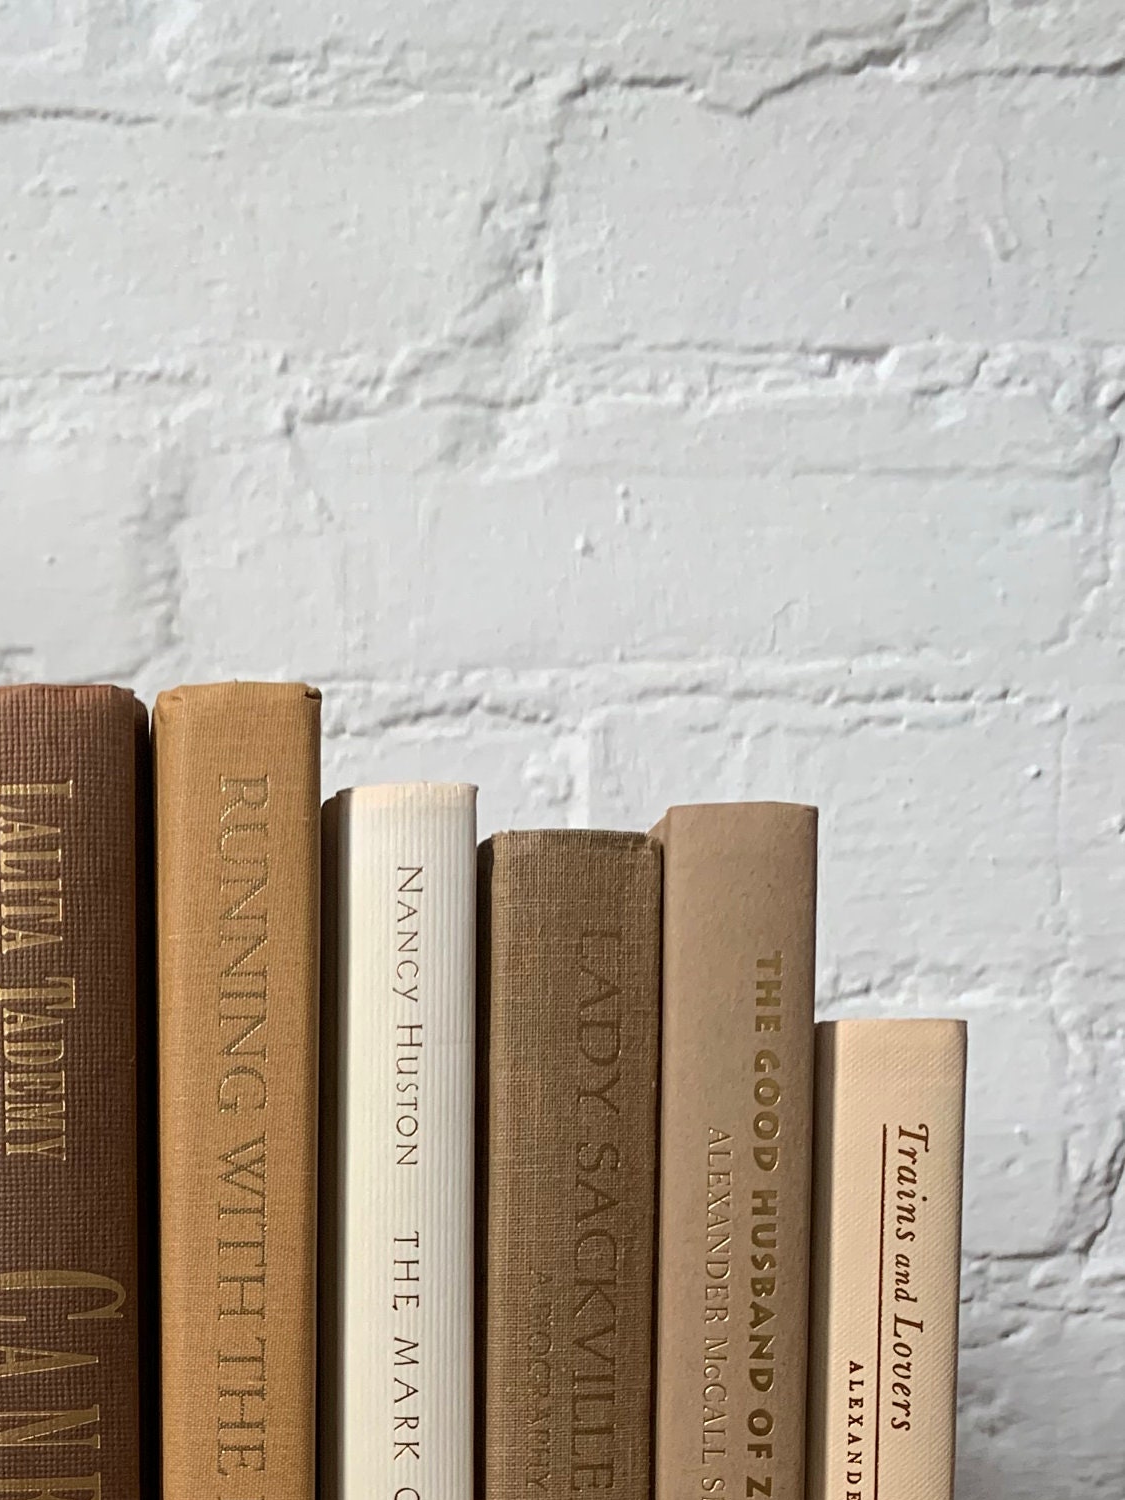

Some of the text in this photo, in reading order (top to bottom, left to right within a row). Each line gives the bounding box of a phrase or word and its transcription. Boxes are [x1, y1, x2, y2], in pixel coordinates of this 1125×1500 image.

[219, 775, 270, 1116] RUNNING
[392, 865, 424, 1168] NANCY HUSTON
[755, 951, 784, 1034] THE
[752, 1048, 782, 1173] GOOD
[218, 1131, 267, 1320] WITH
[393, 1230, 421, 1312] THE
[571, 927, 623, 1494] LADY SACKVILLE
[703, 1126, 734, 1325] ALEXANDER
[747, 1189, 780, 1393] HUSBAND
[890, 1122, 931, 1432] Trains and Lovers
[218, 1337, 266, 1477] THE
[393, 1336, 421, 1461] MARK
[701, 1336, 729, 1465] McCALL
[747, 1408, 774, 1460] OF
